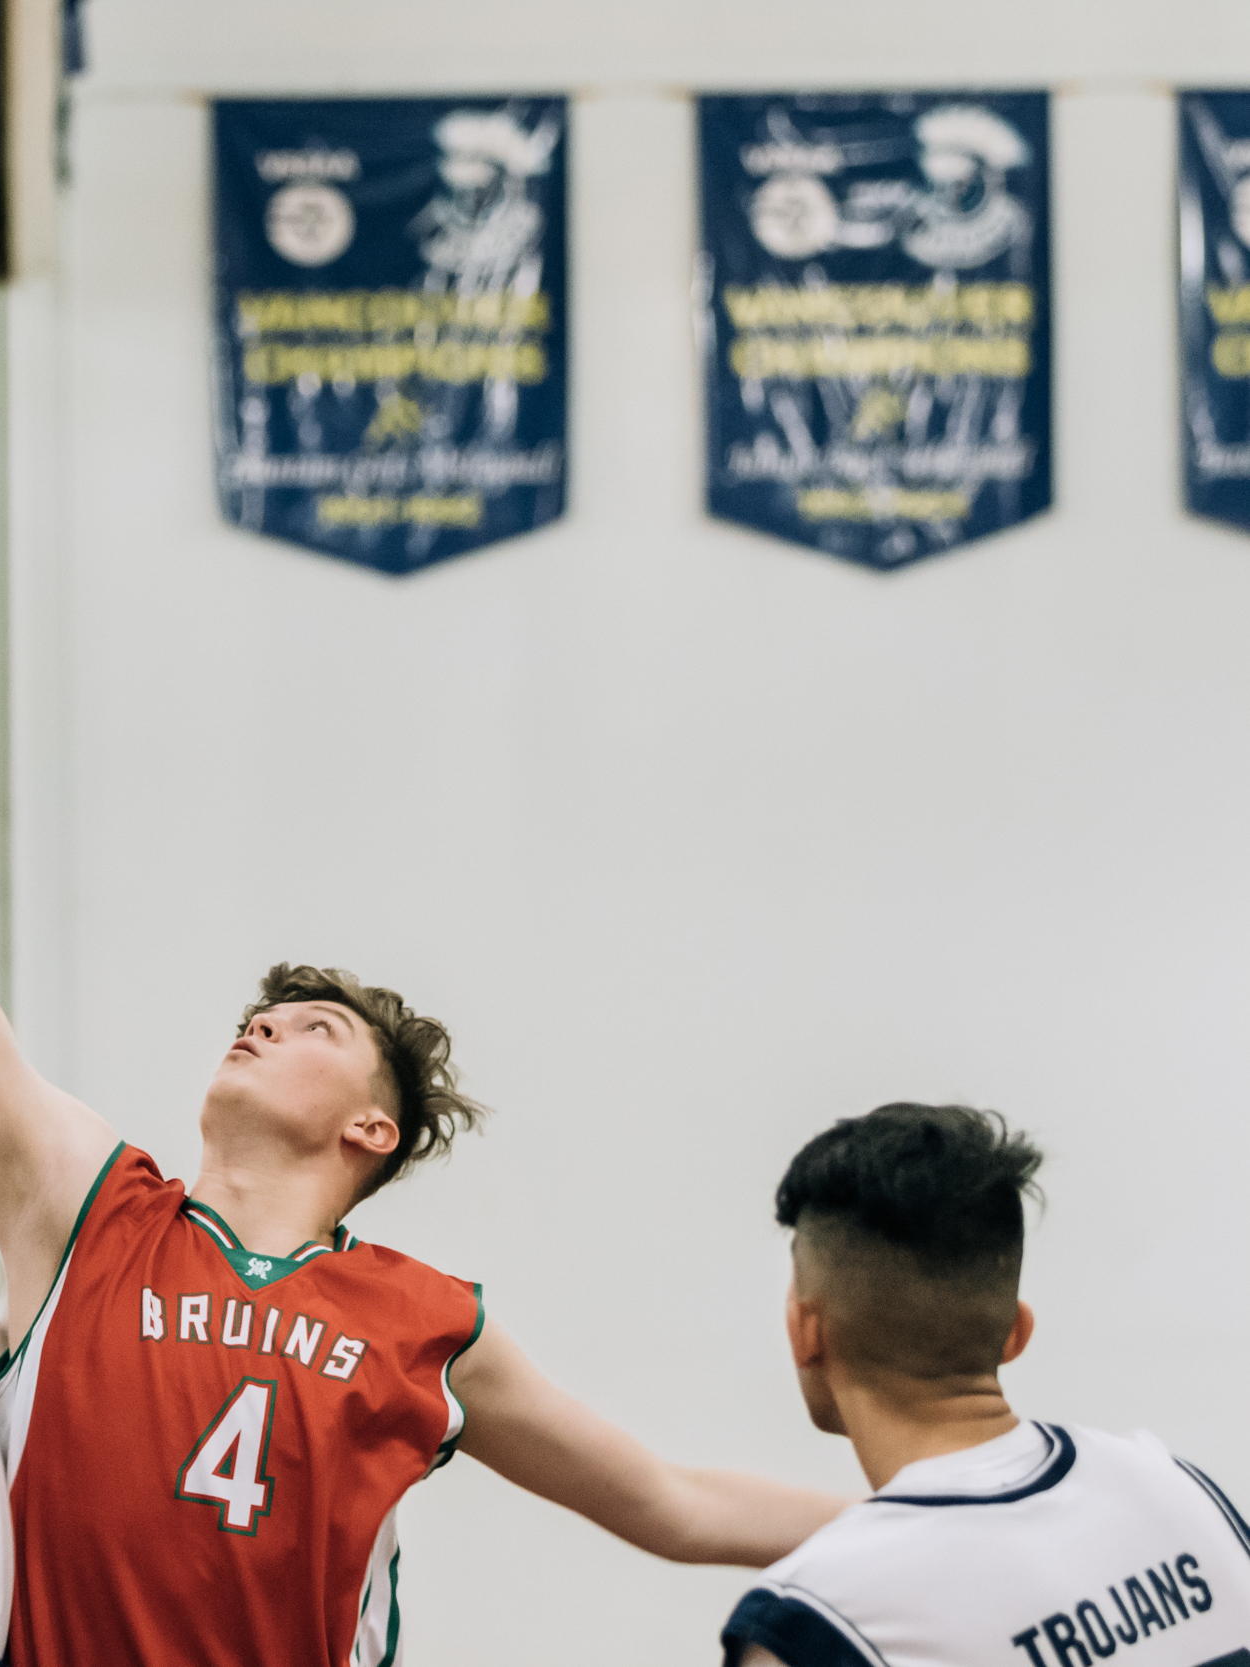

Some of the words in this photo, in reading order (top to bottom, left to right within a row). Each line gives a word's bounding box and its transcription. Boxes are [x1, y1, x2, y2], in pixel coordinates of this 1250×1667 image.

[140, 1285, 369, 1383] BRUINS
[174, 1376, 277, 1538] 4
[1011, 1553, 1213, 1667] TROJANS
